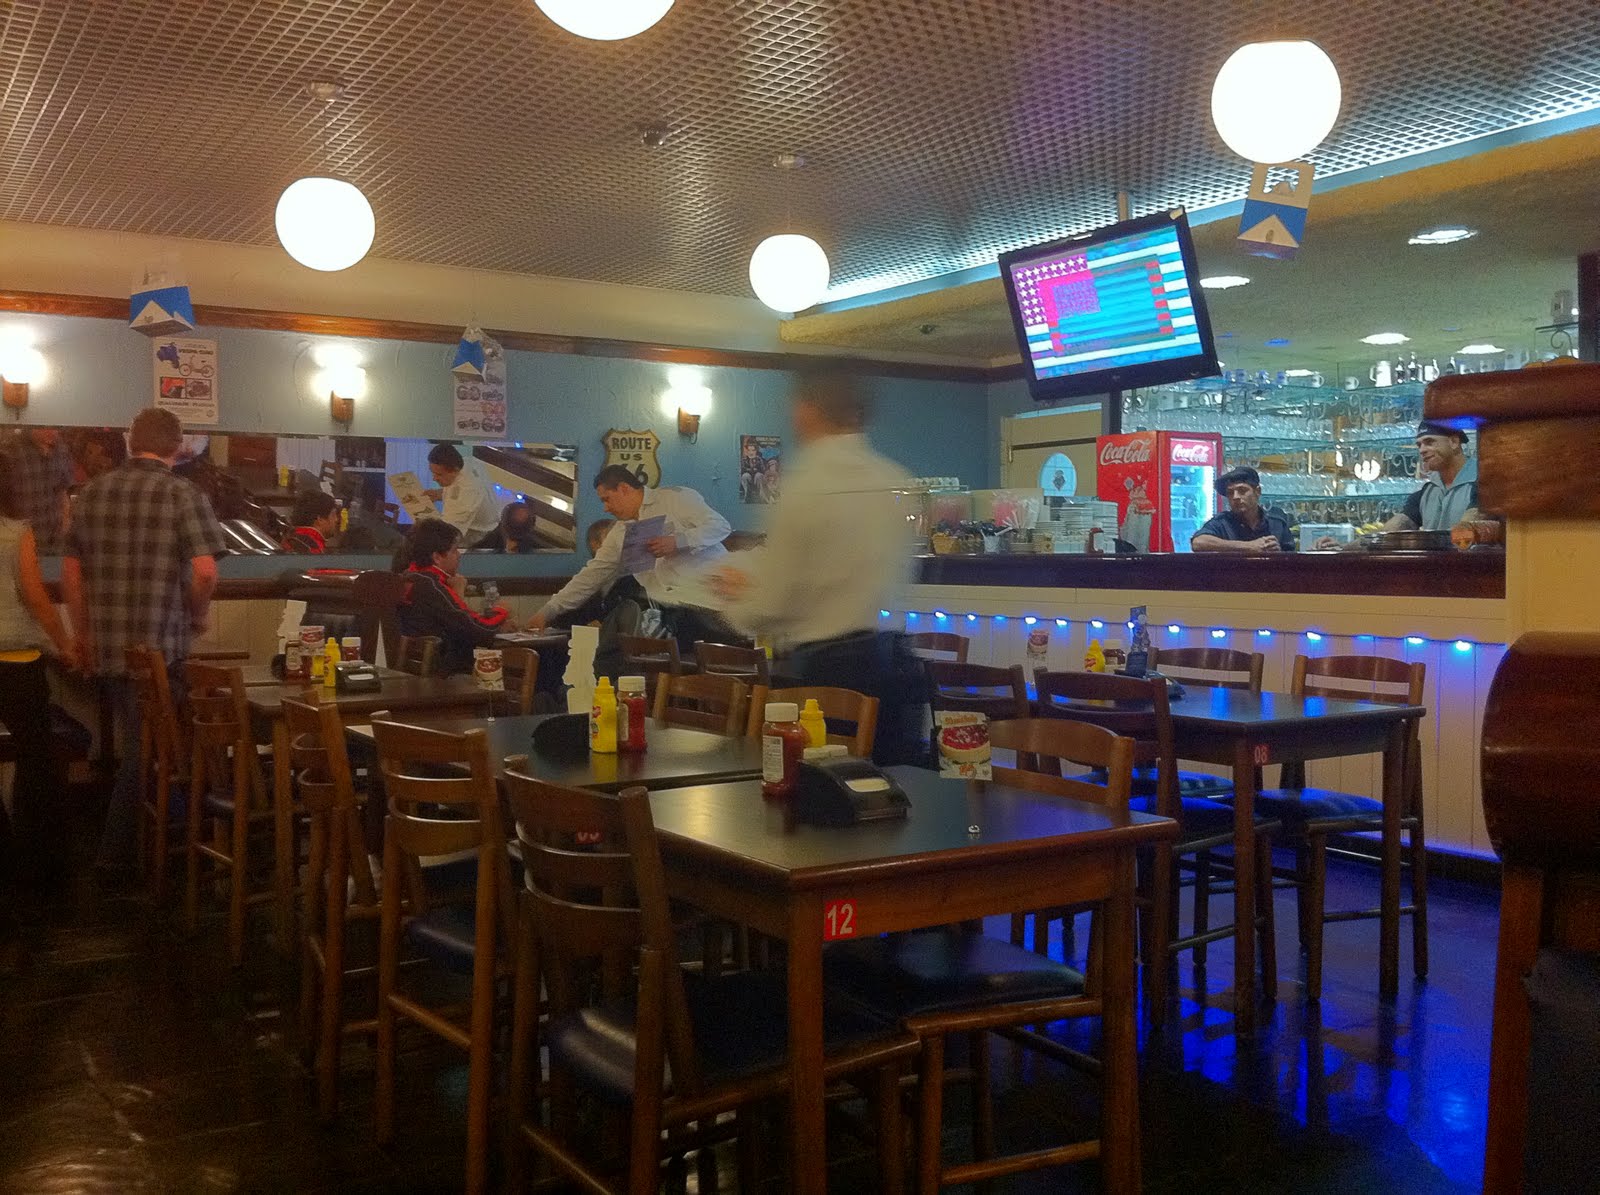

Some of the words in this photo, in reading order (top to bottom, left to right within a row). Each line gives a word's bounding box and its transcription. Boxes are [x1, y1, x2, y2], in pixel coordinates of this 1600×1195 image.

[611, 437, 652, 450] ROUTE
[620, 453, 643, 461] US
[621, 463, 649, 487] 6
[827, 903, 853, 936] 12
